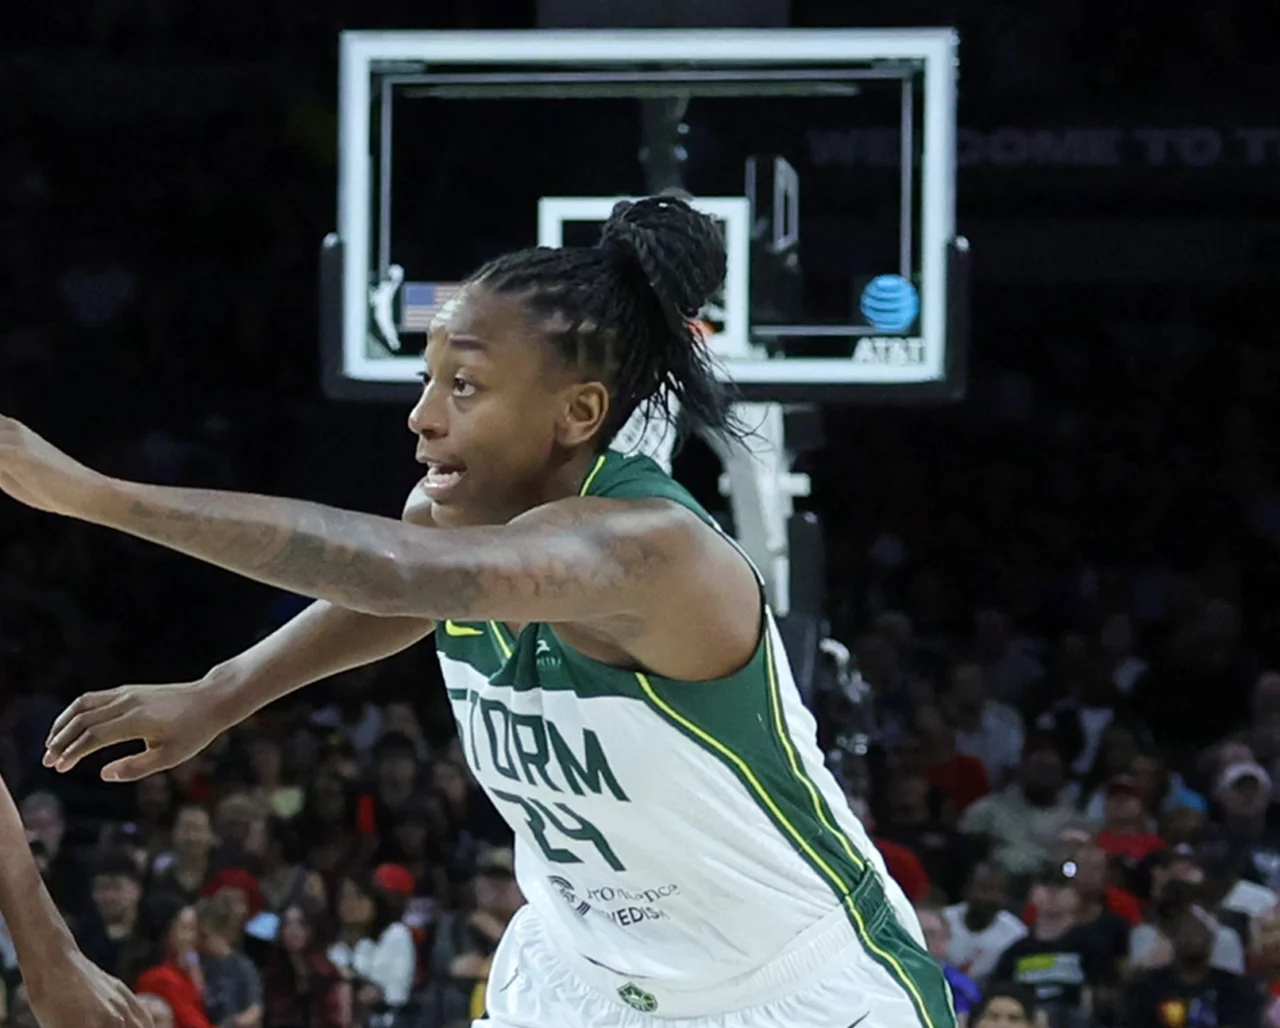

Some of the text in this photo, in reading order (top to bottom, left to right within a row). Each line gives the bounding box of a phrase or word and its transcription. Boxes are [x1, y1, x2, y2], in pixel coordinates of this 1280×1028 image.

[807, 126, 1122, 167] WECOME
[1133, 126, 1222, 167] TO
[489, 787, 627, 872] 24
[593, 906, 671, 927] EDIS
